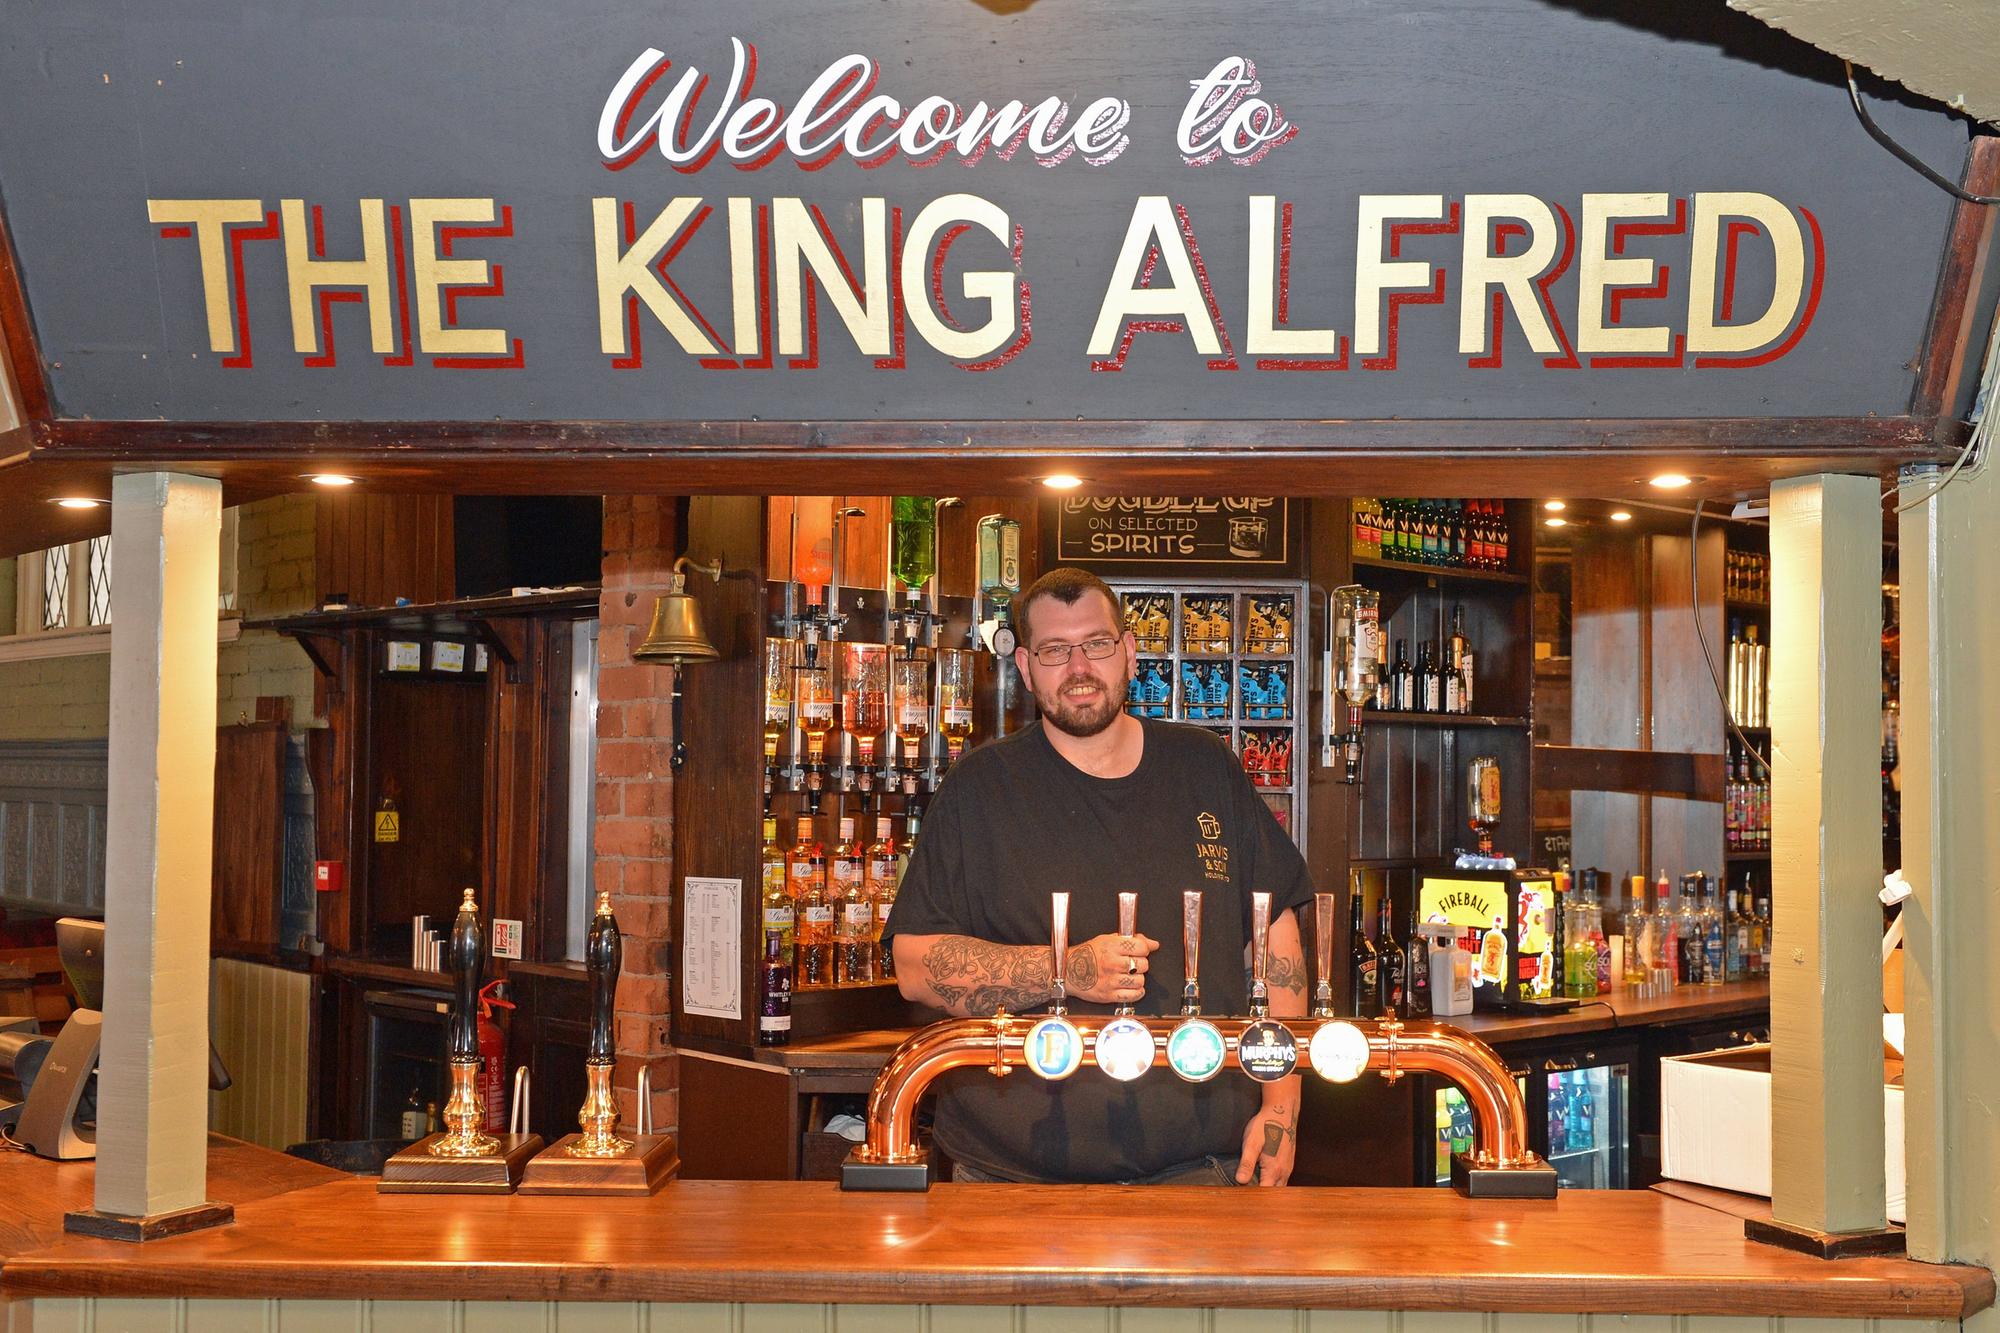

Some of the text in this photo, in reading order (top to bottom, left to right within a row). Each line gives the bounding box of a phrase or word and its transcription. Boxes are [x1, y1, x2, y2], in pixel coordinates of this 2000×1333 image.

[598, 36, 1297, 172] Welcome to
[147, 191, 1825, 370] THE KING ALFRED
[1088, 517, 1199, 532] ON SELECTED
[1090, 534, 1195, 554] SPIRITS
[1196, 843, 1229, 860] JARVIS
[1205, 859, 1214, 870] &
[1438, 892, 1490, 916] FIREBALL
[1041, 1031, 1068, 1068] F
[1242, 1043, 1296, 1062] MURPHY'S
